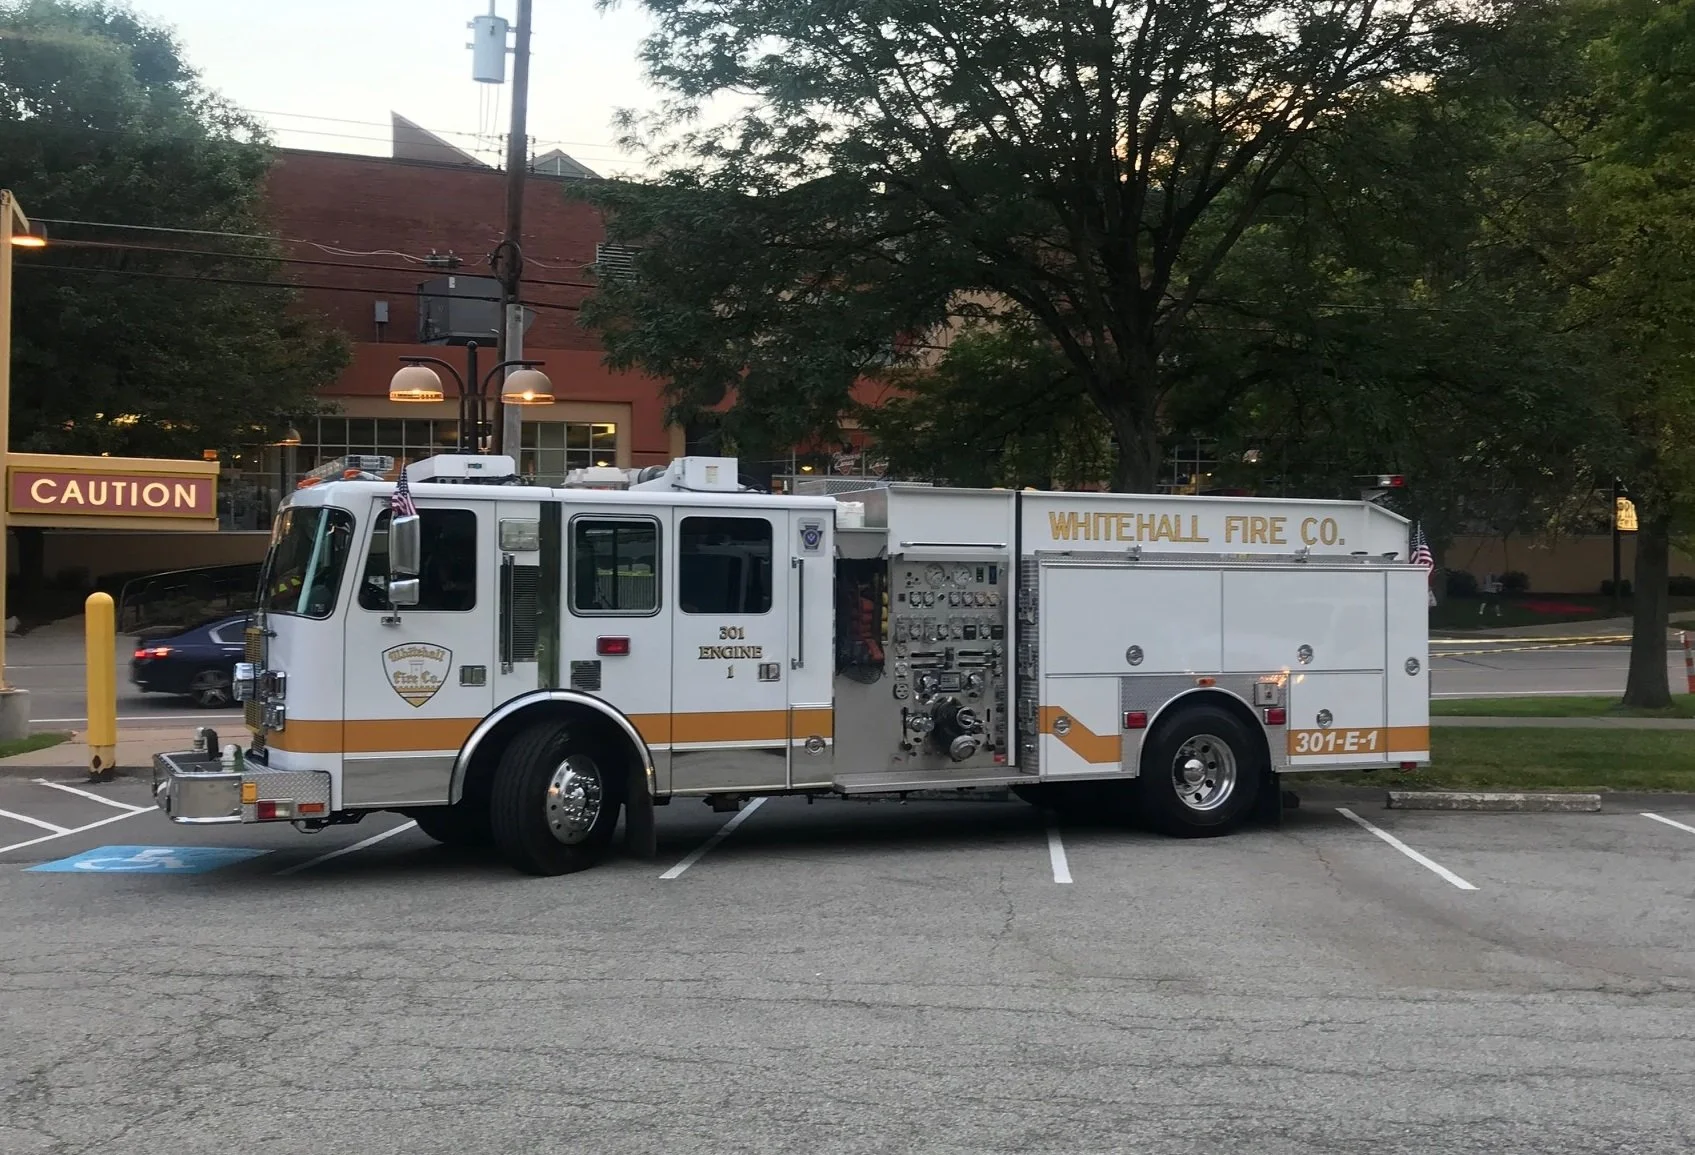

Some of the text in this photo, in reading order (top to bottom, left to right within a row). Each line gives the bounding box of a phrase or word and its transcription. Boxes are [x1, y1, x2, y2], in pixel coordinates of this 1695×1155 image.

[30, 478, 196, 508] CAUTION
[1049, 511, 1345, 545] WHITEHALL FIRE CO.
[719, 626, 745, 640] 301
[698, 645, 763, 660] ENGINE
[393, 671, 419, 684] Fire
[726, 664, 735, 679] 1
[1295, 730, 1378, 753] 301-E-1
